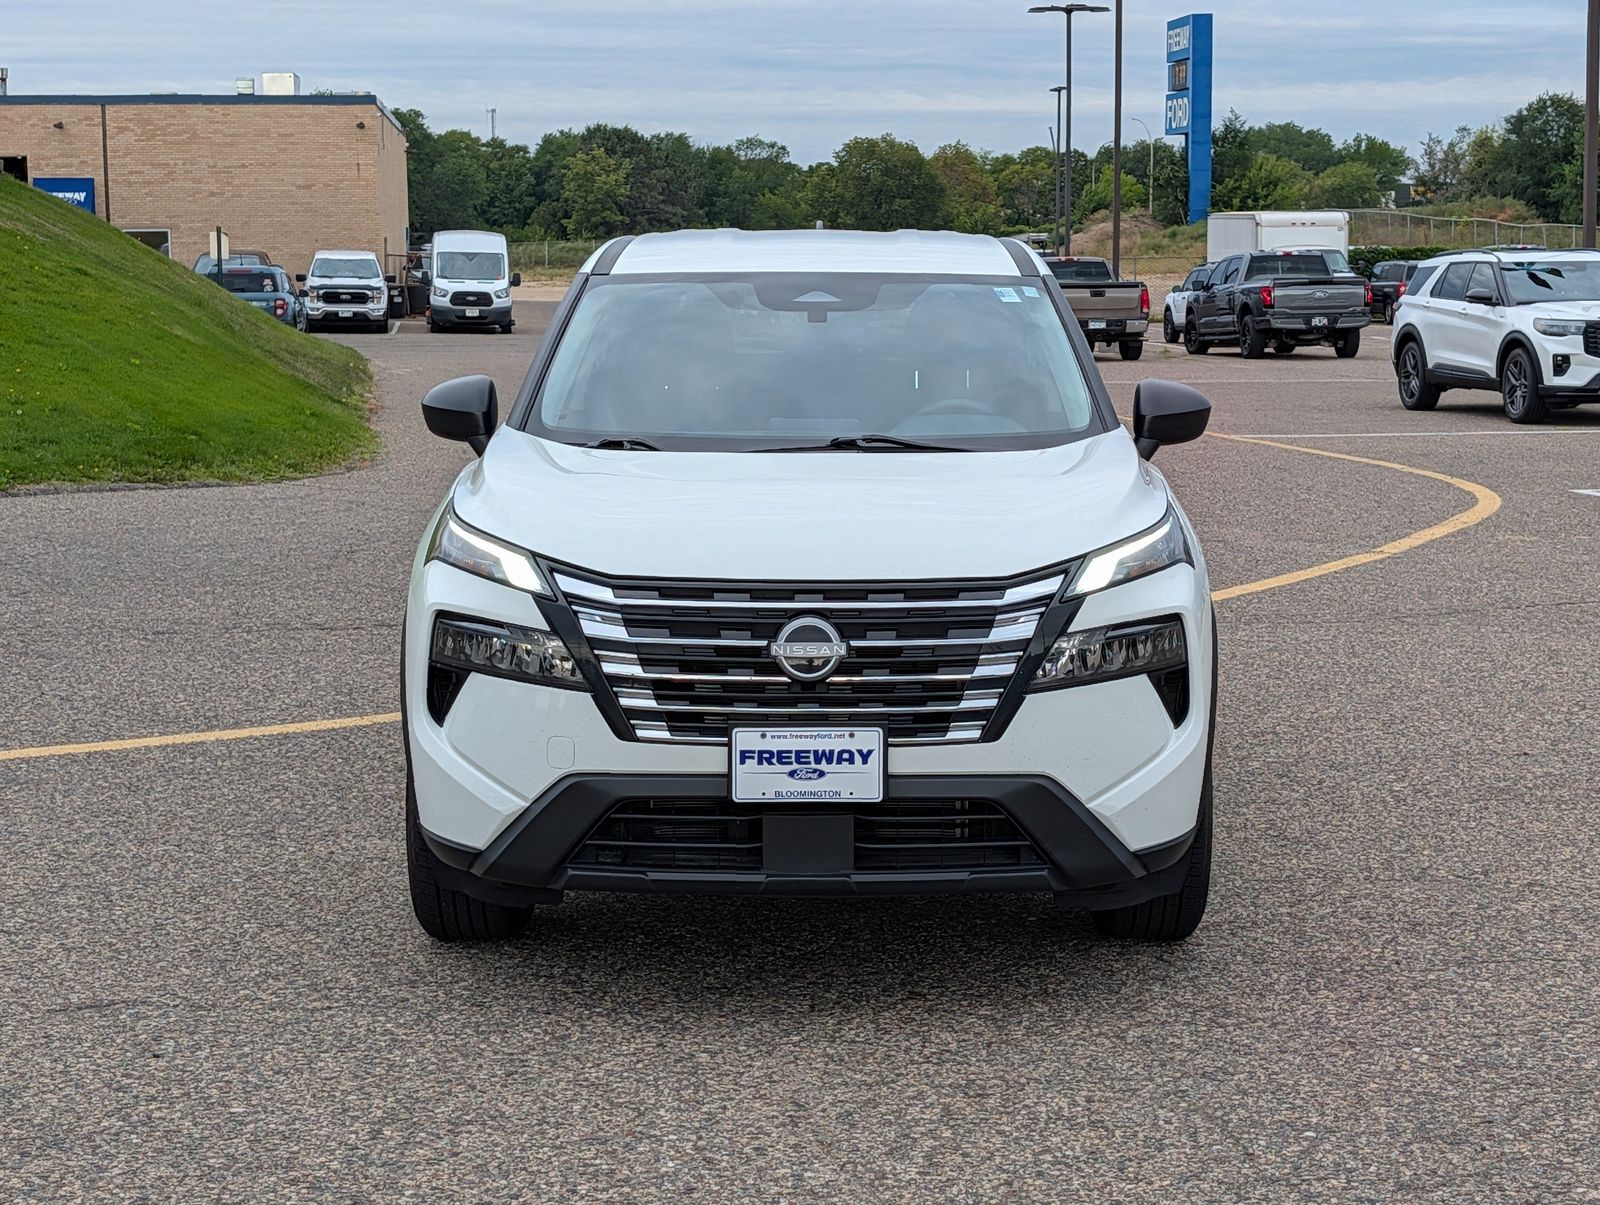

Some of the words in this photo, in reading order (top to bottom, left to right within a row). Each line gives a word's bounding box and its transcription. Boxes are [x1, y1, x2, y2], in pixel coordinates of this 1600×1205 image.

[1166, 97, 1189, 130] FORD
[772, 644, 847, 656] NISSAN
[770, 732, 846, 740] www.freewayford.net
[739, 749, 876, 766] FREEWAY
[793, 768, 820, 779] Ford
[774, 790, 842, 798] BLOOMINGTON
